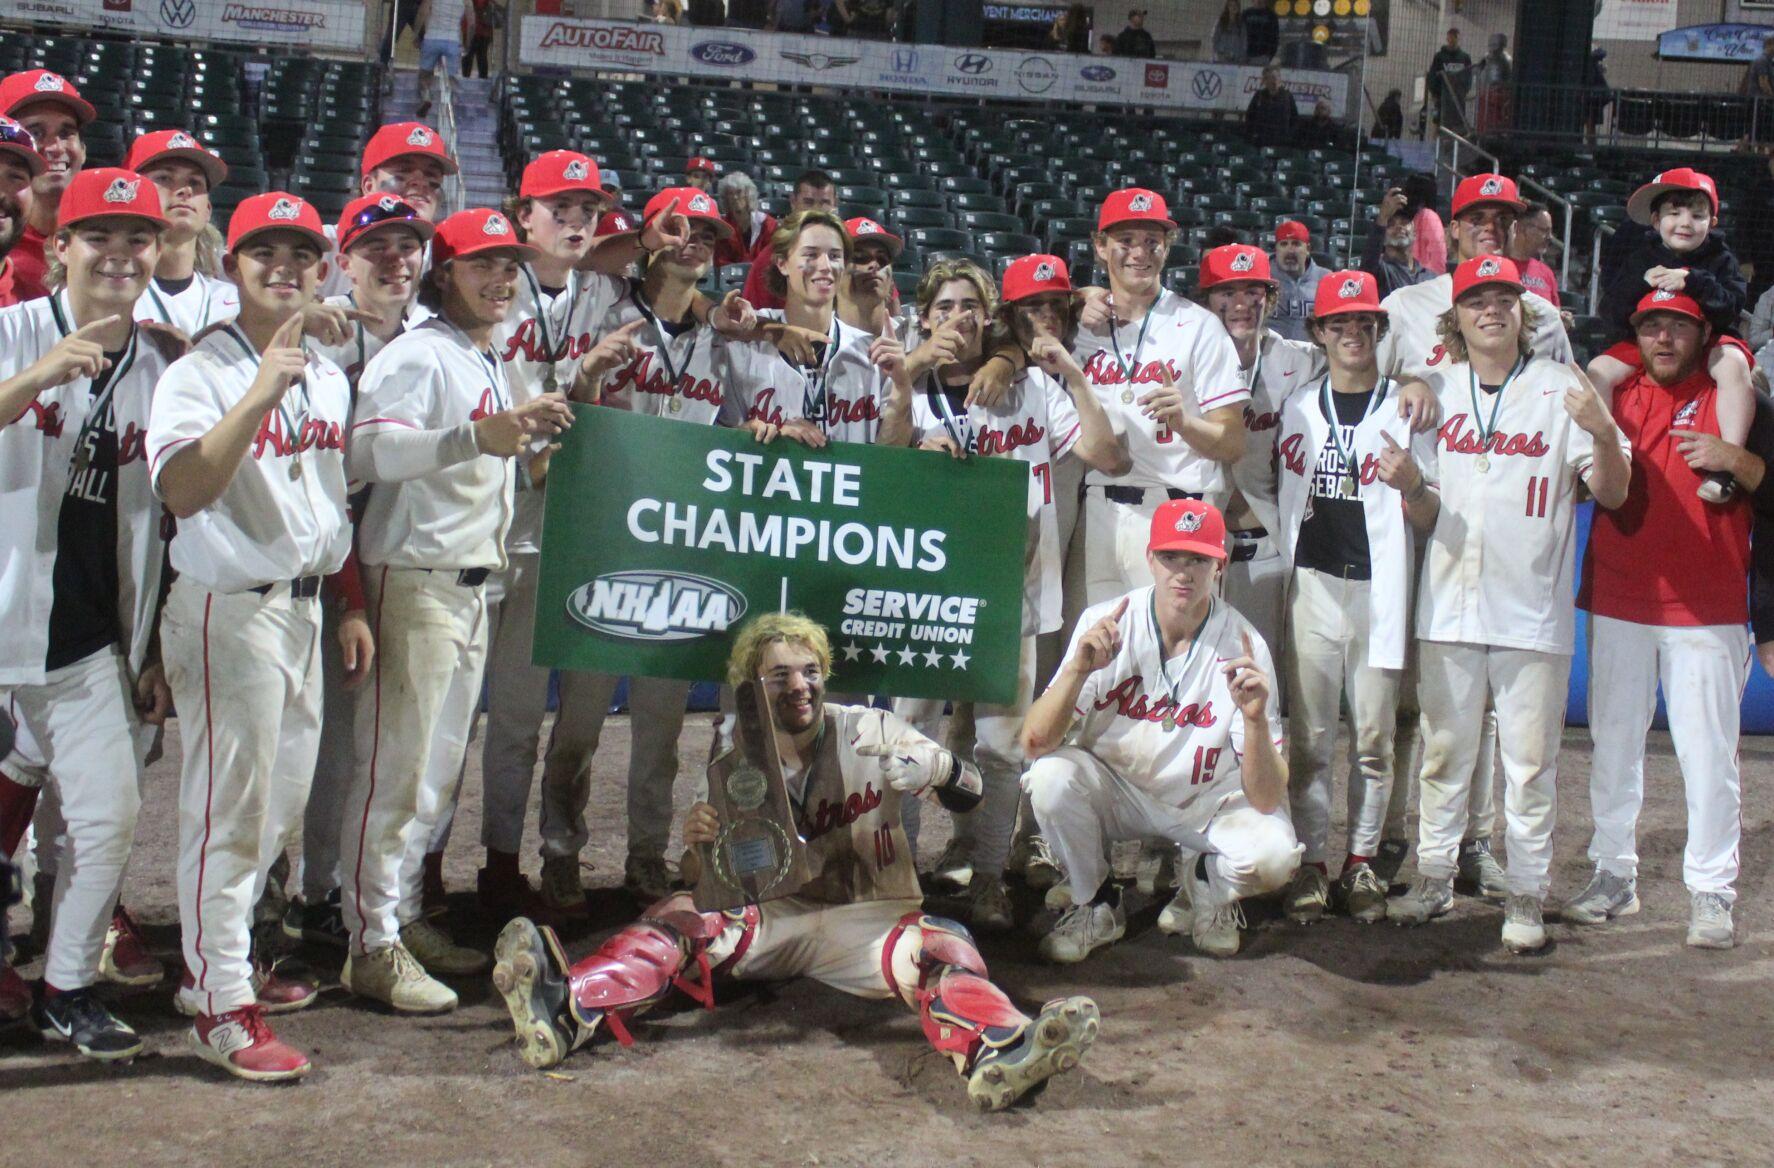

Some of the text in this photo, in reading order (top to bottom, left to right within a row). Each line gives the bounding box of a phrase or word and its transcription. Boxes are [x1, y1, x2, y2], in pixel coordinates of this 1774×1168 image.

[16, 3, 74, 14] SUBARU
[100, 15, 135, 25] TOYOTA
[221, 4, 326, 28] MANCHESTER
[539, 22, 665, 56] AUTOFAIR
[702, 44, 742, 63] Ford
[879, 73, 927, 84] HONDA
[947, 76, 999, 88] HYUNDAI
[1013, 70, 1059, 80] NISSAN
[1074, 84, 1121, 95] SUBARU
[1140, 91, 1170, 99] TOYOTA
[702, 449, 861, 508] STATE
[1032, 462, 1051, 505] 7
[1526, 476, 1549, 517] 11
[626, 498, 947, 572] CHAMPIONS
[841, 619, 974, 645] CREDIT UNION
[1191, 745, 1222, 785] 19
[874, 822, 896, 872] 10
